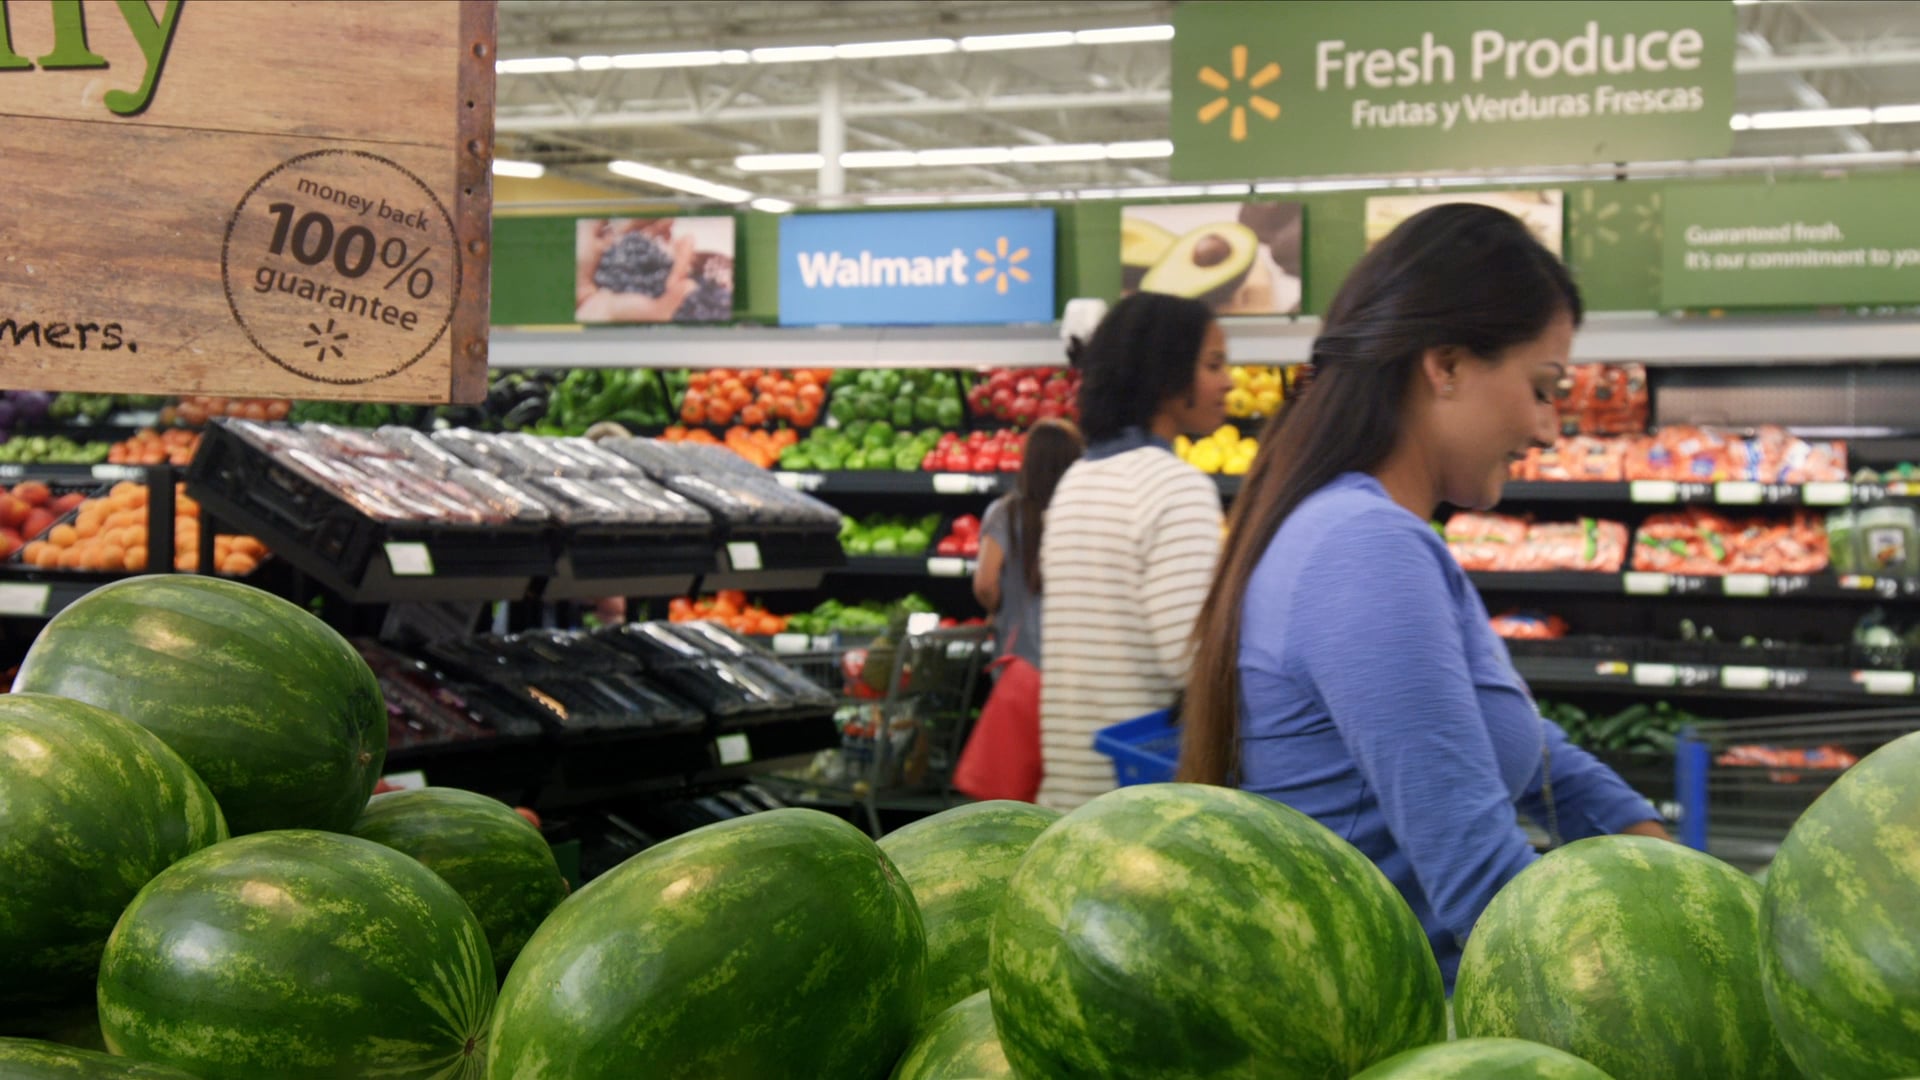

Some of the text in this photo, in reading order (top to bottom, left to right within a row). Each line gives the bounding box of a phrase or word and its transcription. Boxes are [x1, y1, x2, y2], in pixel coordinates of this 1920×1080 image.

[1315, 21, 1704, 90] Fresh Produce
[1352, 85, 1704, 131] Frutas y Verduras Frescas
[297, 178, 429, 232] money back
[268, 202, 434, 300] 100%
[1686, 221, 1844, 244] Guaranteed fresh.
[798, 248, 968, 288] Walmart
[1686, 251, 1712, 270] It's
[1715, 253, 1745, 270] our
[1749, 249, 1865, 269] commitment
[1870, 249, 1890, 267] to
[254, 265, 418, 331] guarantee
